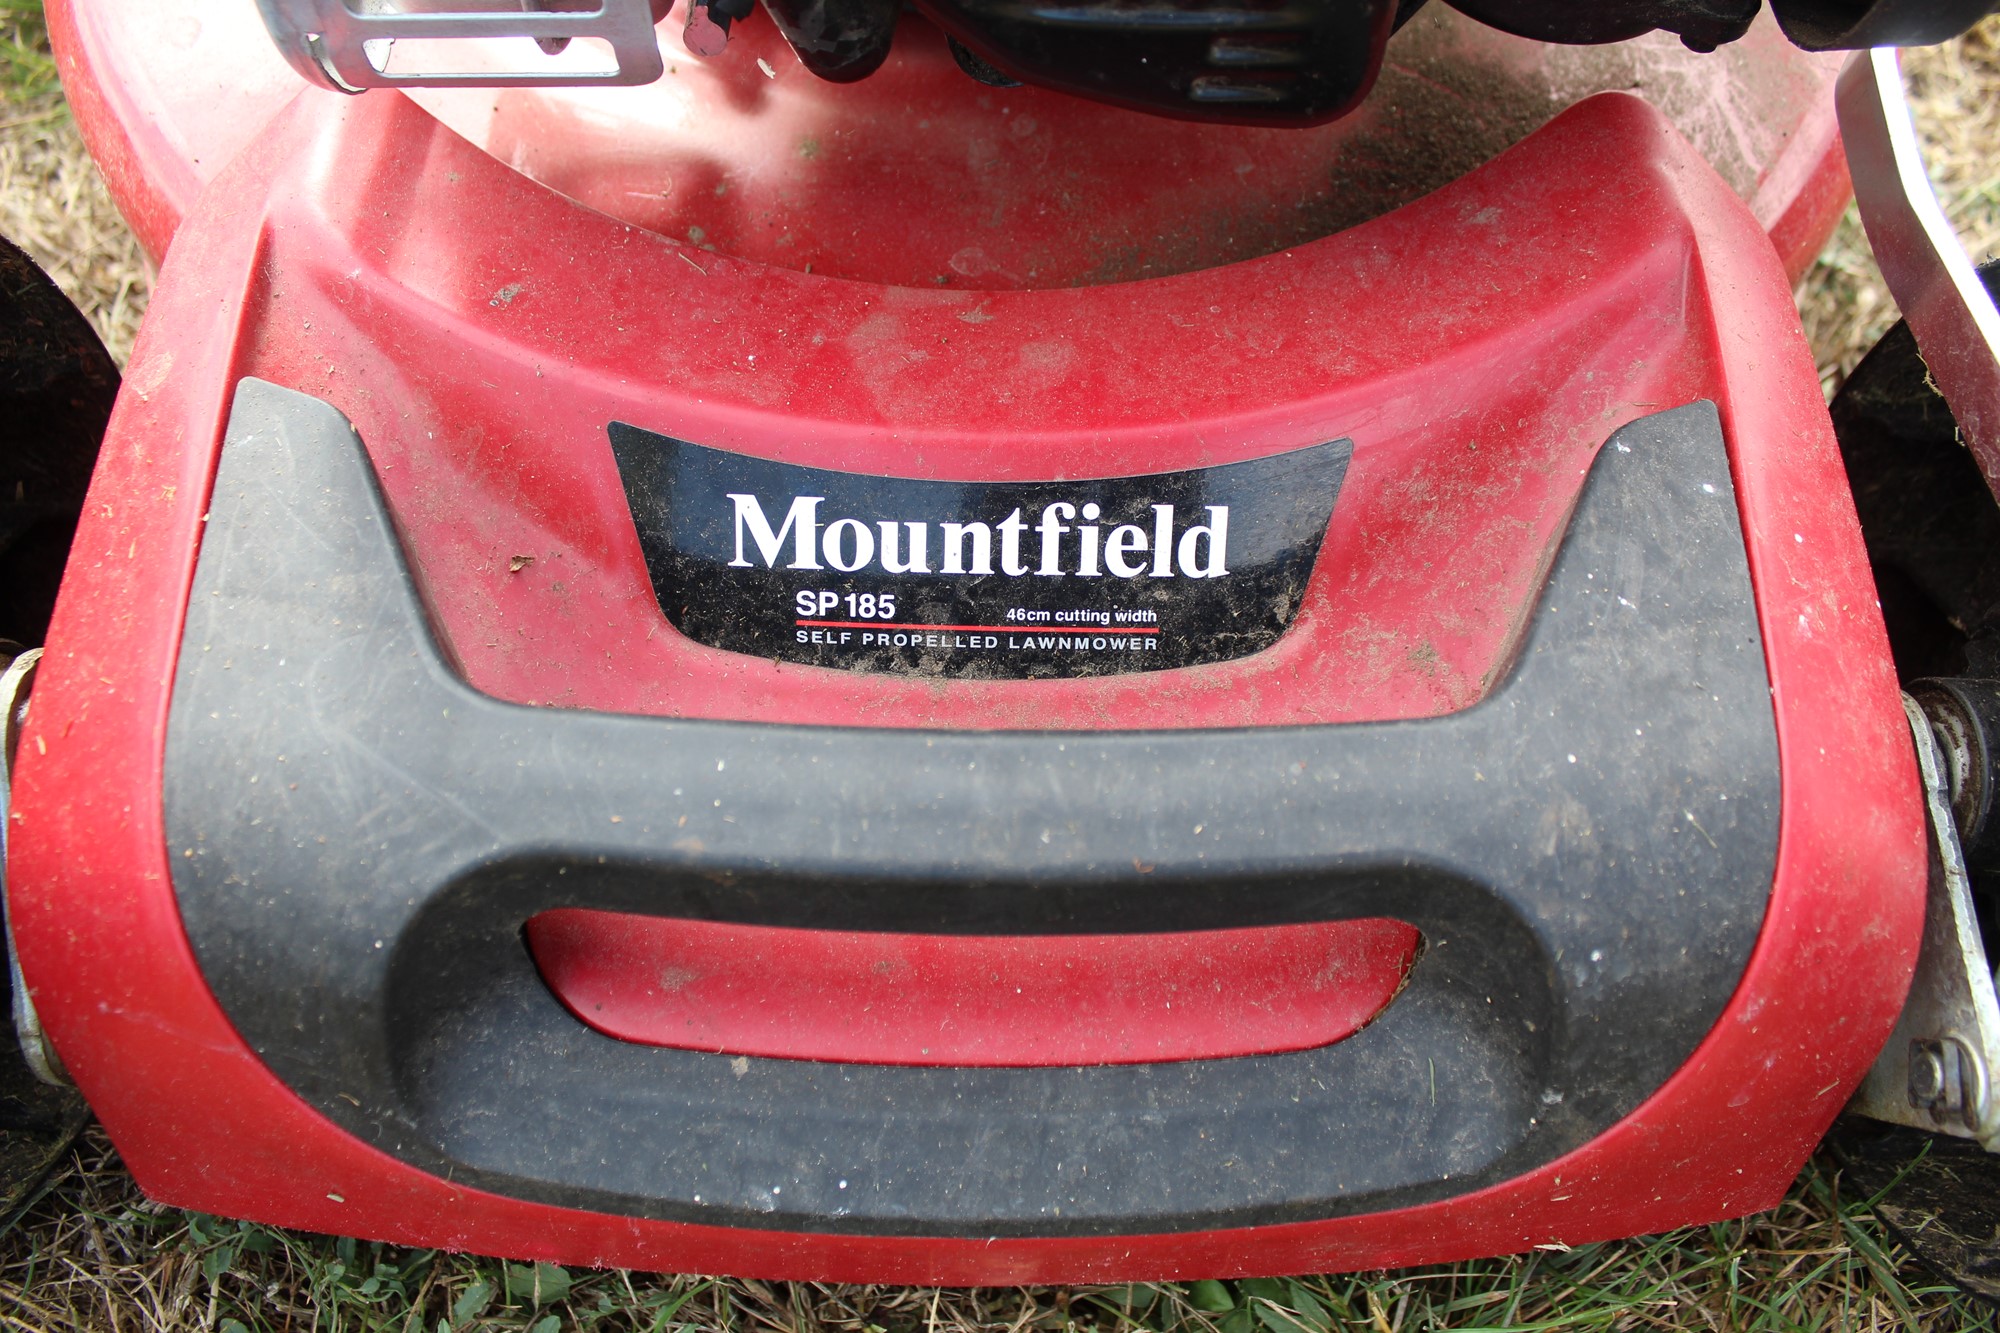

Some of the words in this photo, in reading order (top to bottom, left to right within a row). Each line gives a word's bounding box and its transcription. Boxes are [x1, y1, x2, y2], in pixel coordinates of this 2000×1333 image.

[726, 493, 1230, 579] Mountfield
[795, 590, 838, 617] SP
[845, 593, 896, 620] 185
[1006, 608, 1051, 622] 46cm
[1055, 608, 1110, 625] cutting
[1114, 609, 1158, 623] width
[796, 630, 852, 645] SELF
[862, 632, 998, 649] PROPELLED
[1008, 636, 1158, 651] LAWNMOWER
